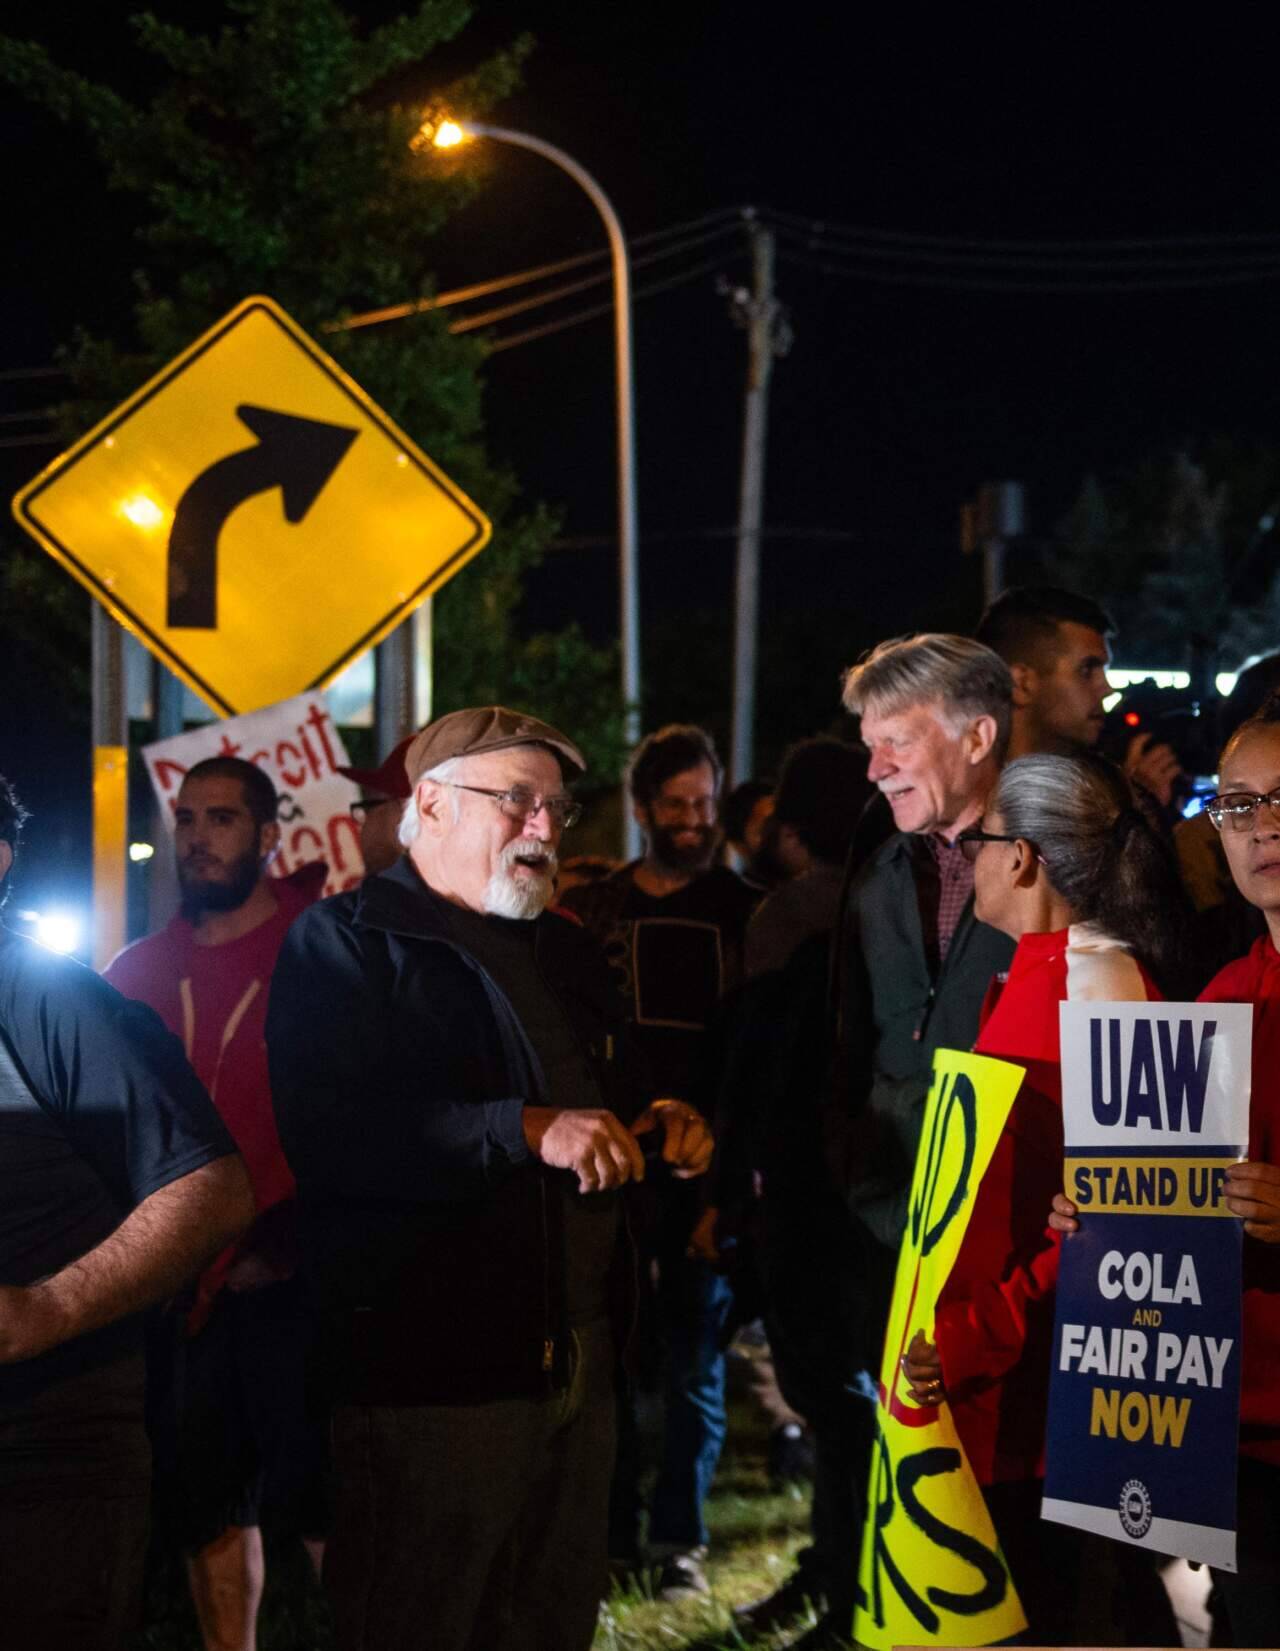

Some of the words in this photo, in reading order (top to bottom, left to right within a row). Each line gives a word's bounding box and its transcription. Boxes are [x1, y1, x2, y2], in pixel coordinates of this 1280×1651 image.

[1090, 1018, 1217, 1133] UAW
[1074, 1166, 1178, 1206] STAND
[1188, 1167, 1226, 1208] UP
[1098, 1250, 1202, 1305] COLA
[1132, 1308, 1162, 1327] AND
[1059, 1323, 1149, 1380] FAIR
[1155, 1332, 1234, 1388] PAY
[1090, 1387, 1192, 1448] NOW
